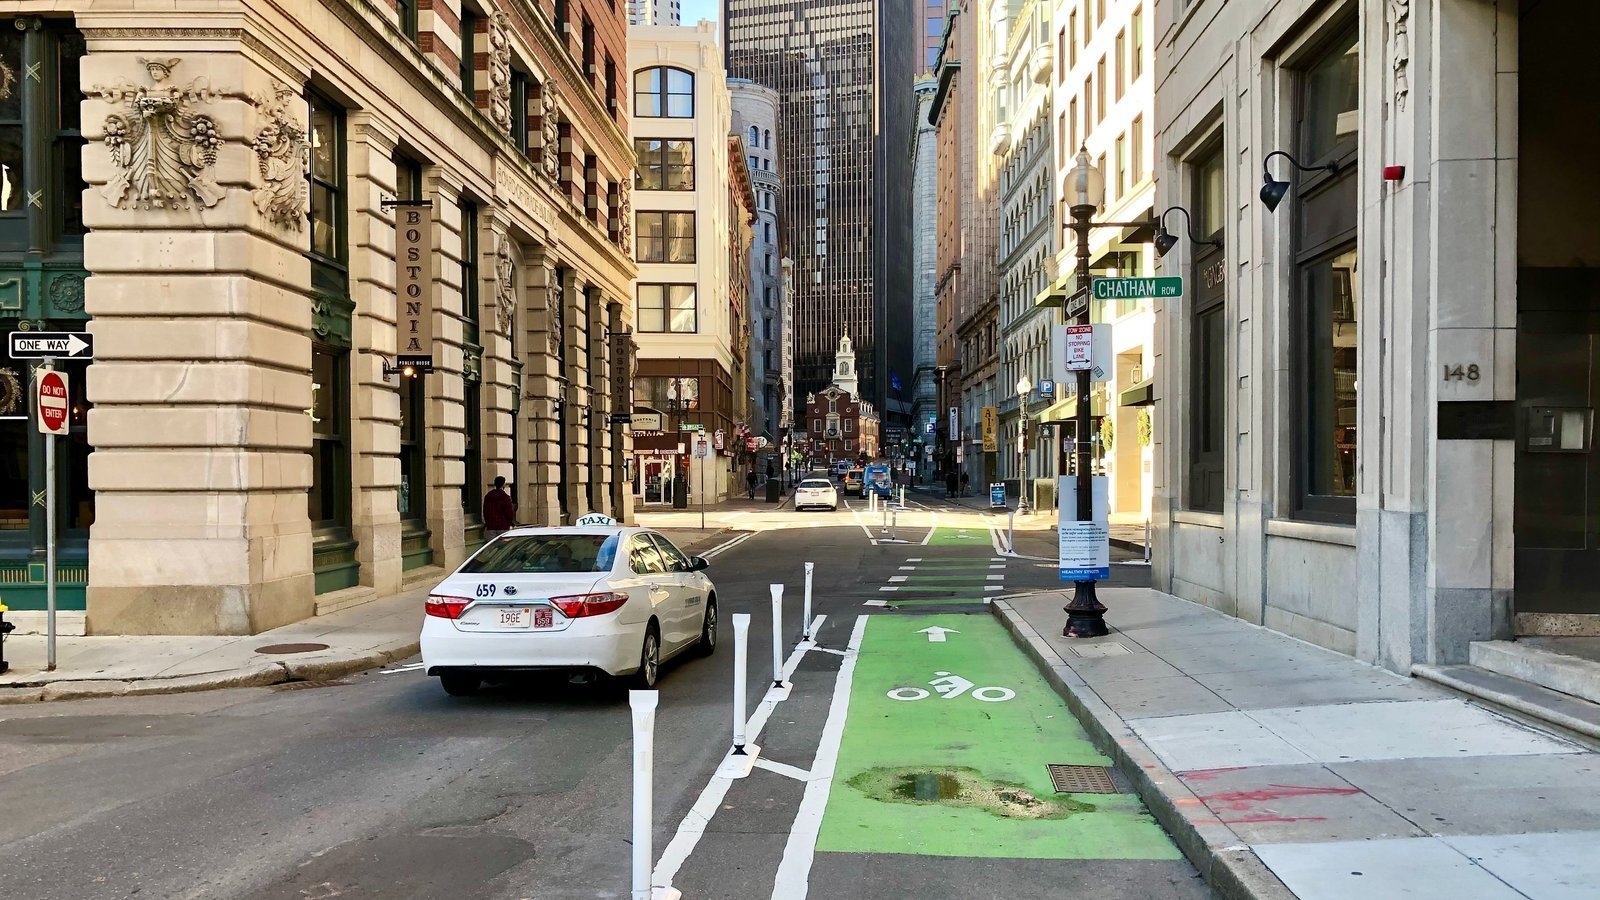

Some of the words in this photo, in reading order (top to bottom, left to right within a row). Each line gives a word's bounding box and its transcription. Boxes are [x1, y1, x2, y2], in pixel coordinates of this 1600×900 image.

[406, 211, 421, 351] BOSTONIA
[1098, 280, 1156, 297] CHATHAM
[1161, 286, 1176, 295] ROW
[19, 340, 41, 350] ONE
[47, 340, 70, 350] WAY
[616, 338, 624, 412] BOSTONIA
[1443, 363, 1480, 382] 148
[42, 385, 51, 394] DO
[53, 386, 64, 396] NOT
[45, 409, 62, 418] ENTER
[580, 516, 611, 525] TAXI
[476, 584, 496, 597] 659
[500, 613, 521, 624] 19GE
[537, 617, 550, 625] 659
